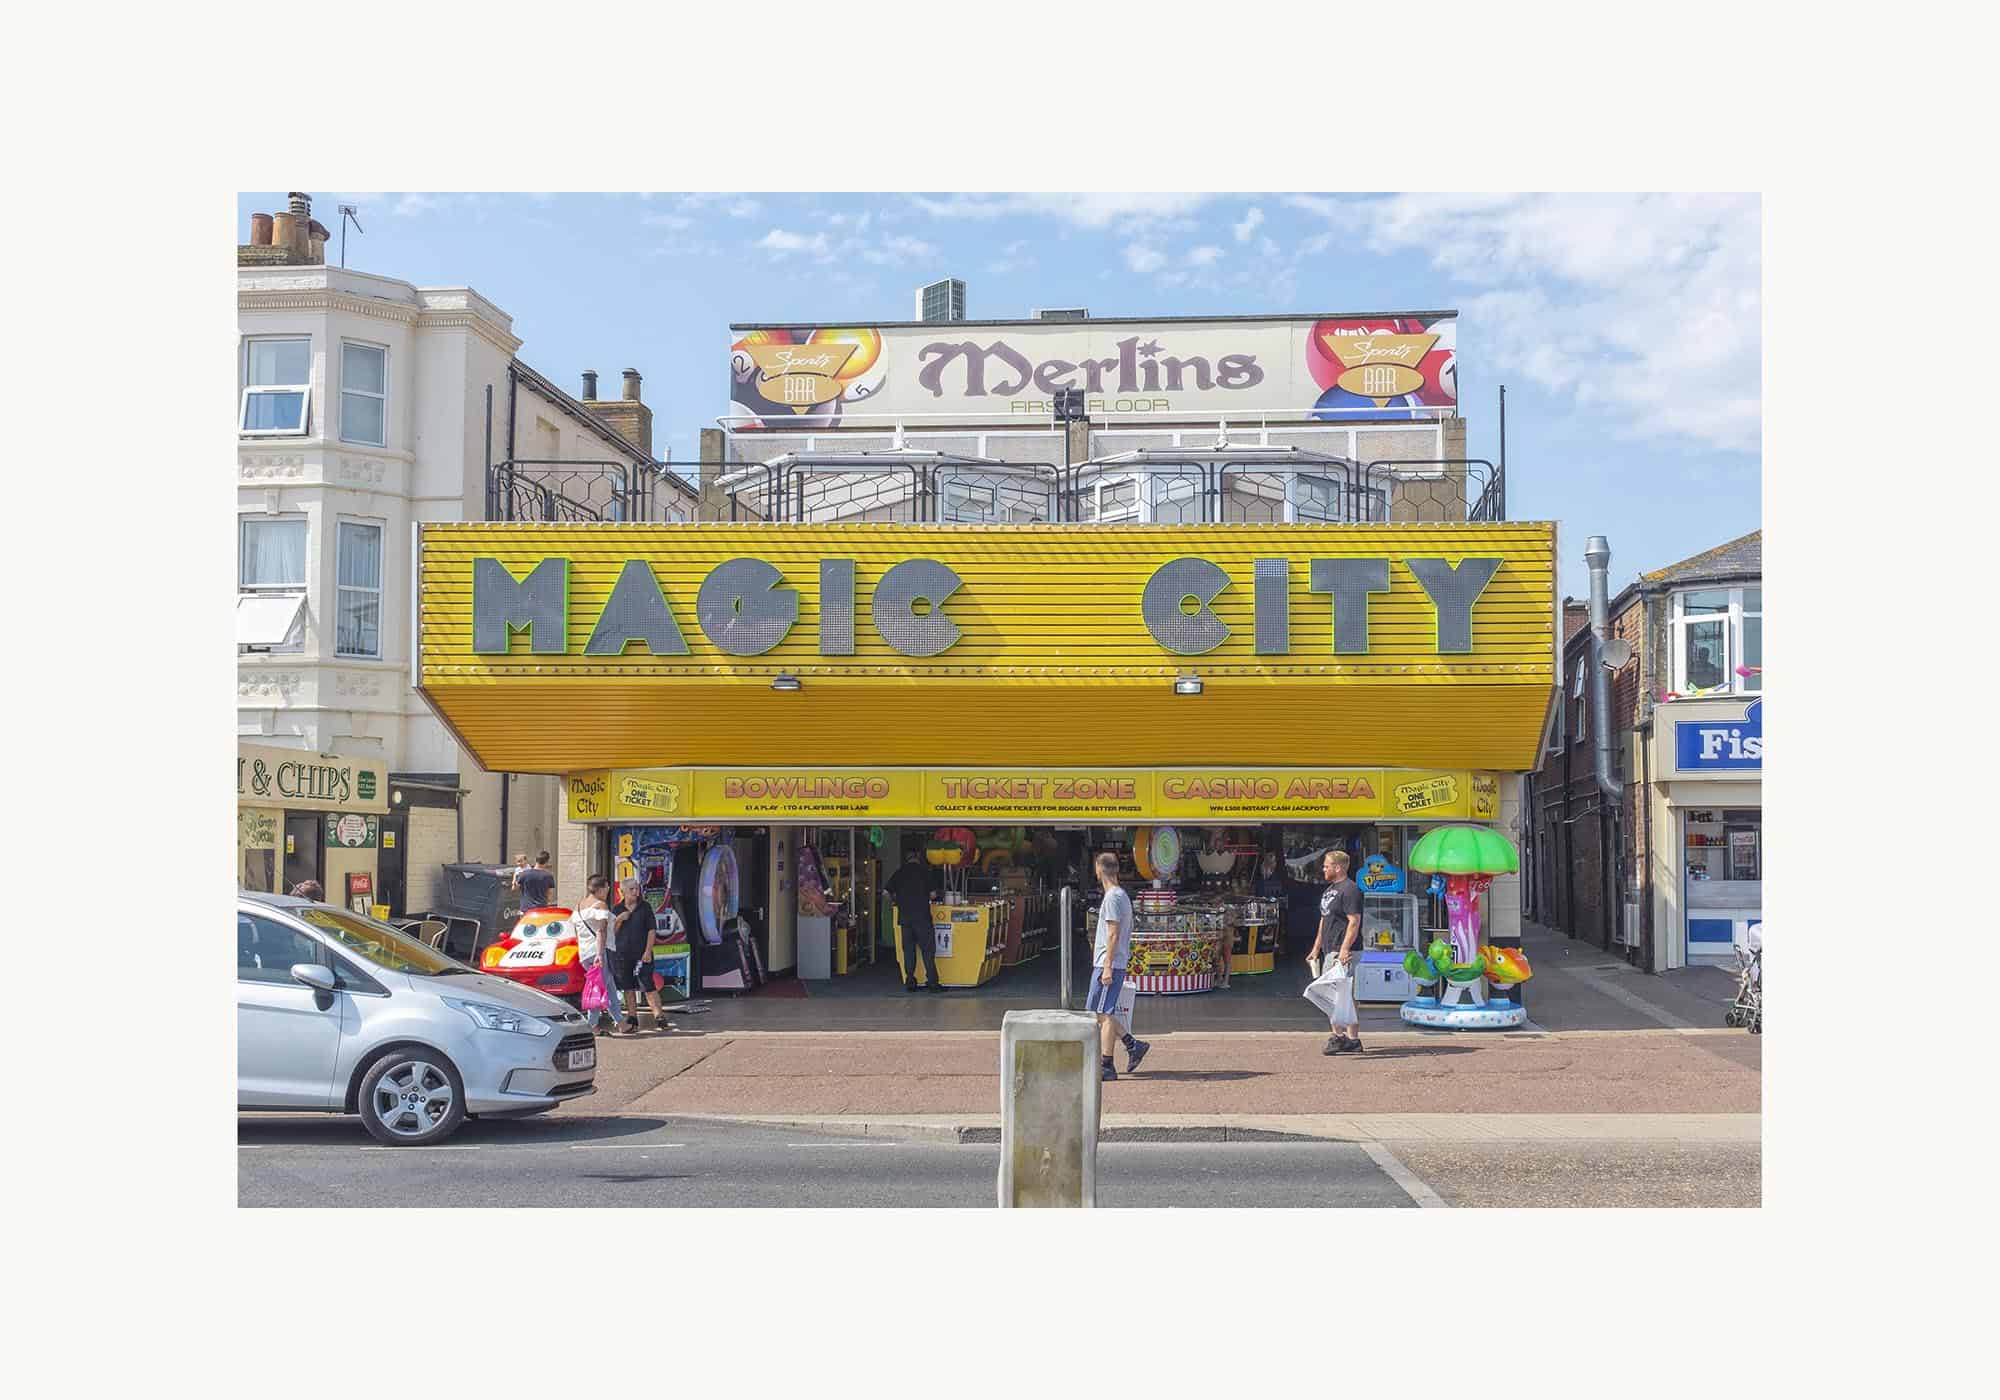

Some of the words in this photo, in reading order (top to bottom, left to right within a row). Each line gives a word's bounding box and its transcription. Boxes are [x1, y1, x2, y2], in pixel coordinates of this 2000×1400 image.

[766, 347, 840, 374] Sports
[1344, 337, 1421, 365] Sports
[733, 355, 750, 373] 2
[918, 336, 1265, 397] Merlins
[784, 377, 816, 401] BAR
[855, 384, 871, 396] 5
[1364, 367, 1397, 393] BAR
[1011, 401, 1055, 413] FIRS
[1089, 400, 1169, 412] FLOOR
[471, 557, 964, 657] MAGIC
[1141, 557, 1504, 655] CITY
[1699, 729, 1761, 759] Fis
[252, 758, 272, 797] &
[277, 760, 351, 804] CHIPS
[571, 778, 606, 796] Magic
[725, 777, 890, 799] BOWLINGO
[942, 777, 1049, 799] TICKET
[1053, 777, 1136, 799] ZONE
[1163, 777, 1279, 799] CASINO
[1284, 777, 1376, 799] AREA
[624, 795, 652, 807] TICKET
[631, 789, 648, 799] ONE
[1403, 798, 1432, 810] TICKET
[1407, 791, 1425, 801] ONE
[576, 798, 599, 816] City
[509, 950, 545, 959] POLICE
